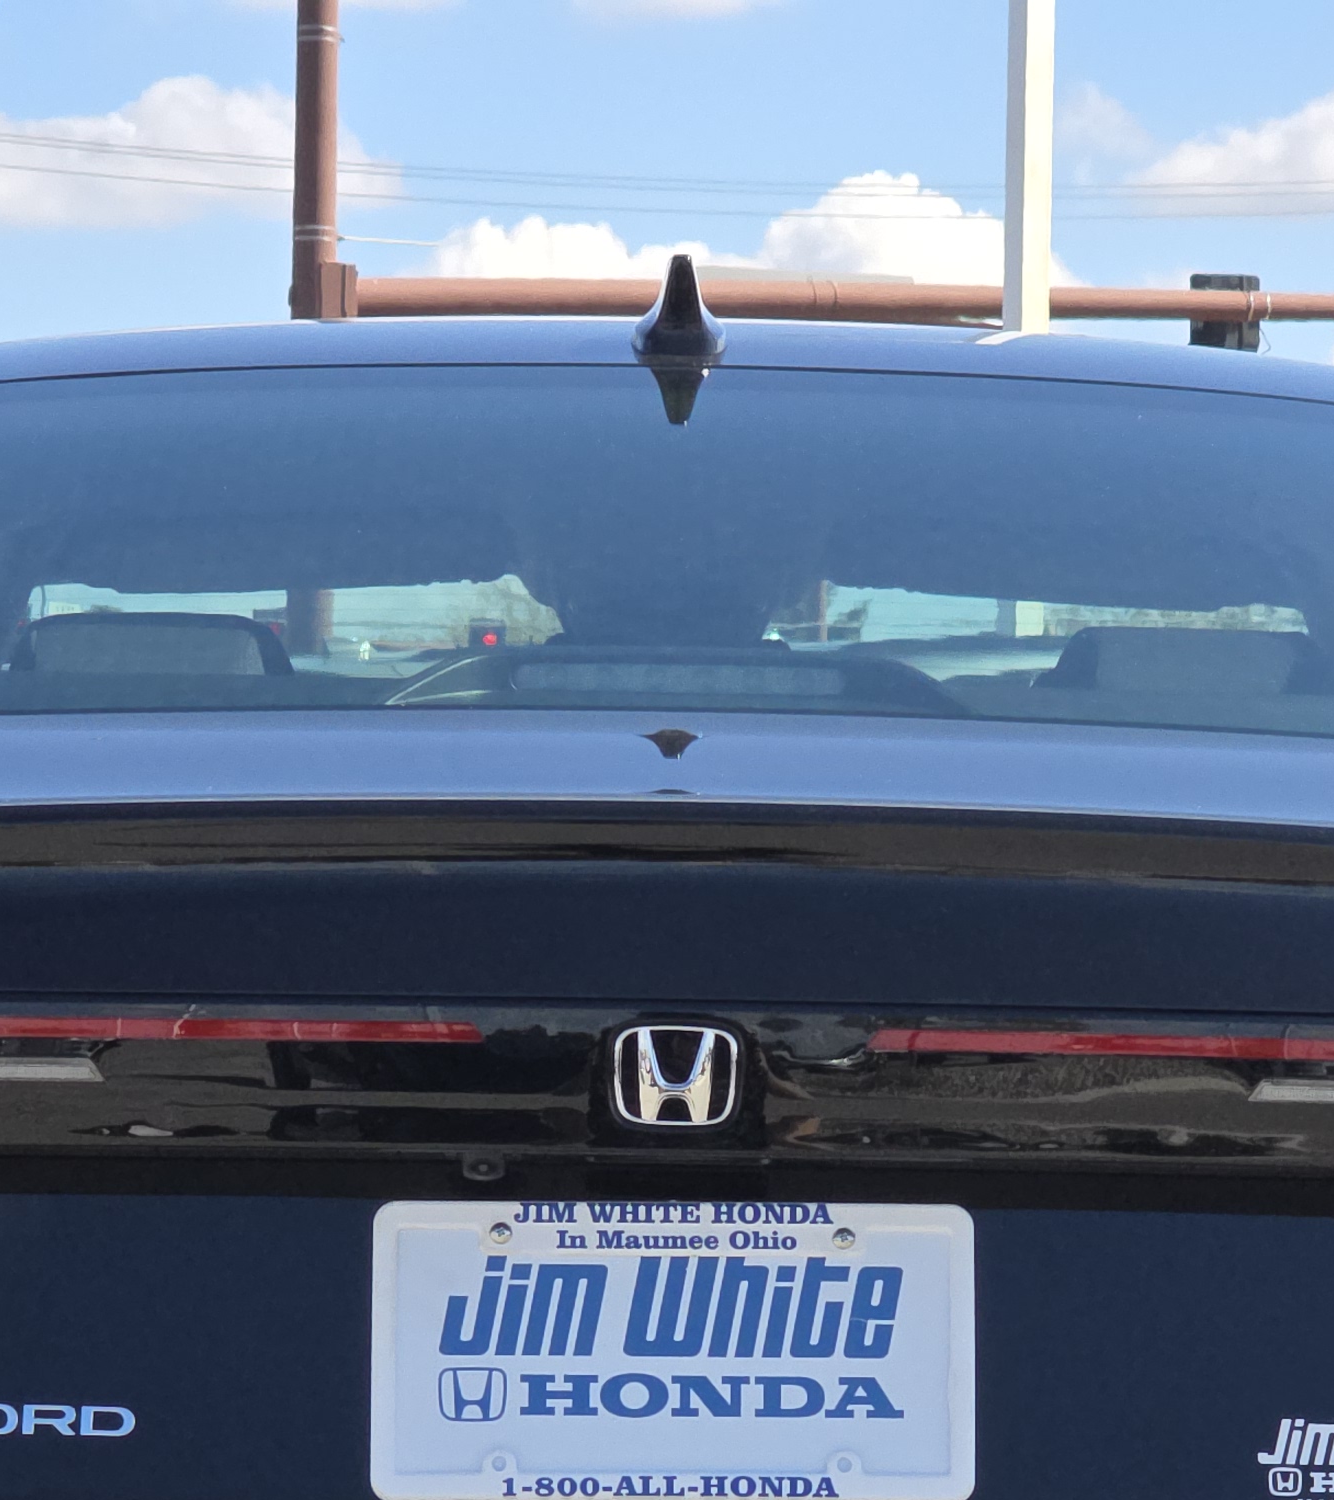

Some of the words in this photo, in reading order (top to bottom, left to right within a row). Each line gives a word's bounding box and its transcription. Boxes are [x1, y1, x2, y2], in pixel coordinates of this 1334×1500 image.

[513, 1202, 578, 1225] JIM
[588, 1202, 702, 1226] WHITE
[712, 1202, 834, 1226] HONDA
[556, 1230, 588, 1250] In
[596, 1231, 720, 1251] Maumee
[728, 1231, 798, 1251] Ohio
[622, 1256, 904, 1359] White
[519, 1372, 905, 1418] HONDA
[501, 1476, 840, 1499] 1-800-ALL-HONDA
